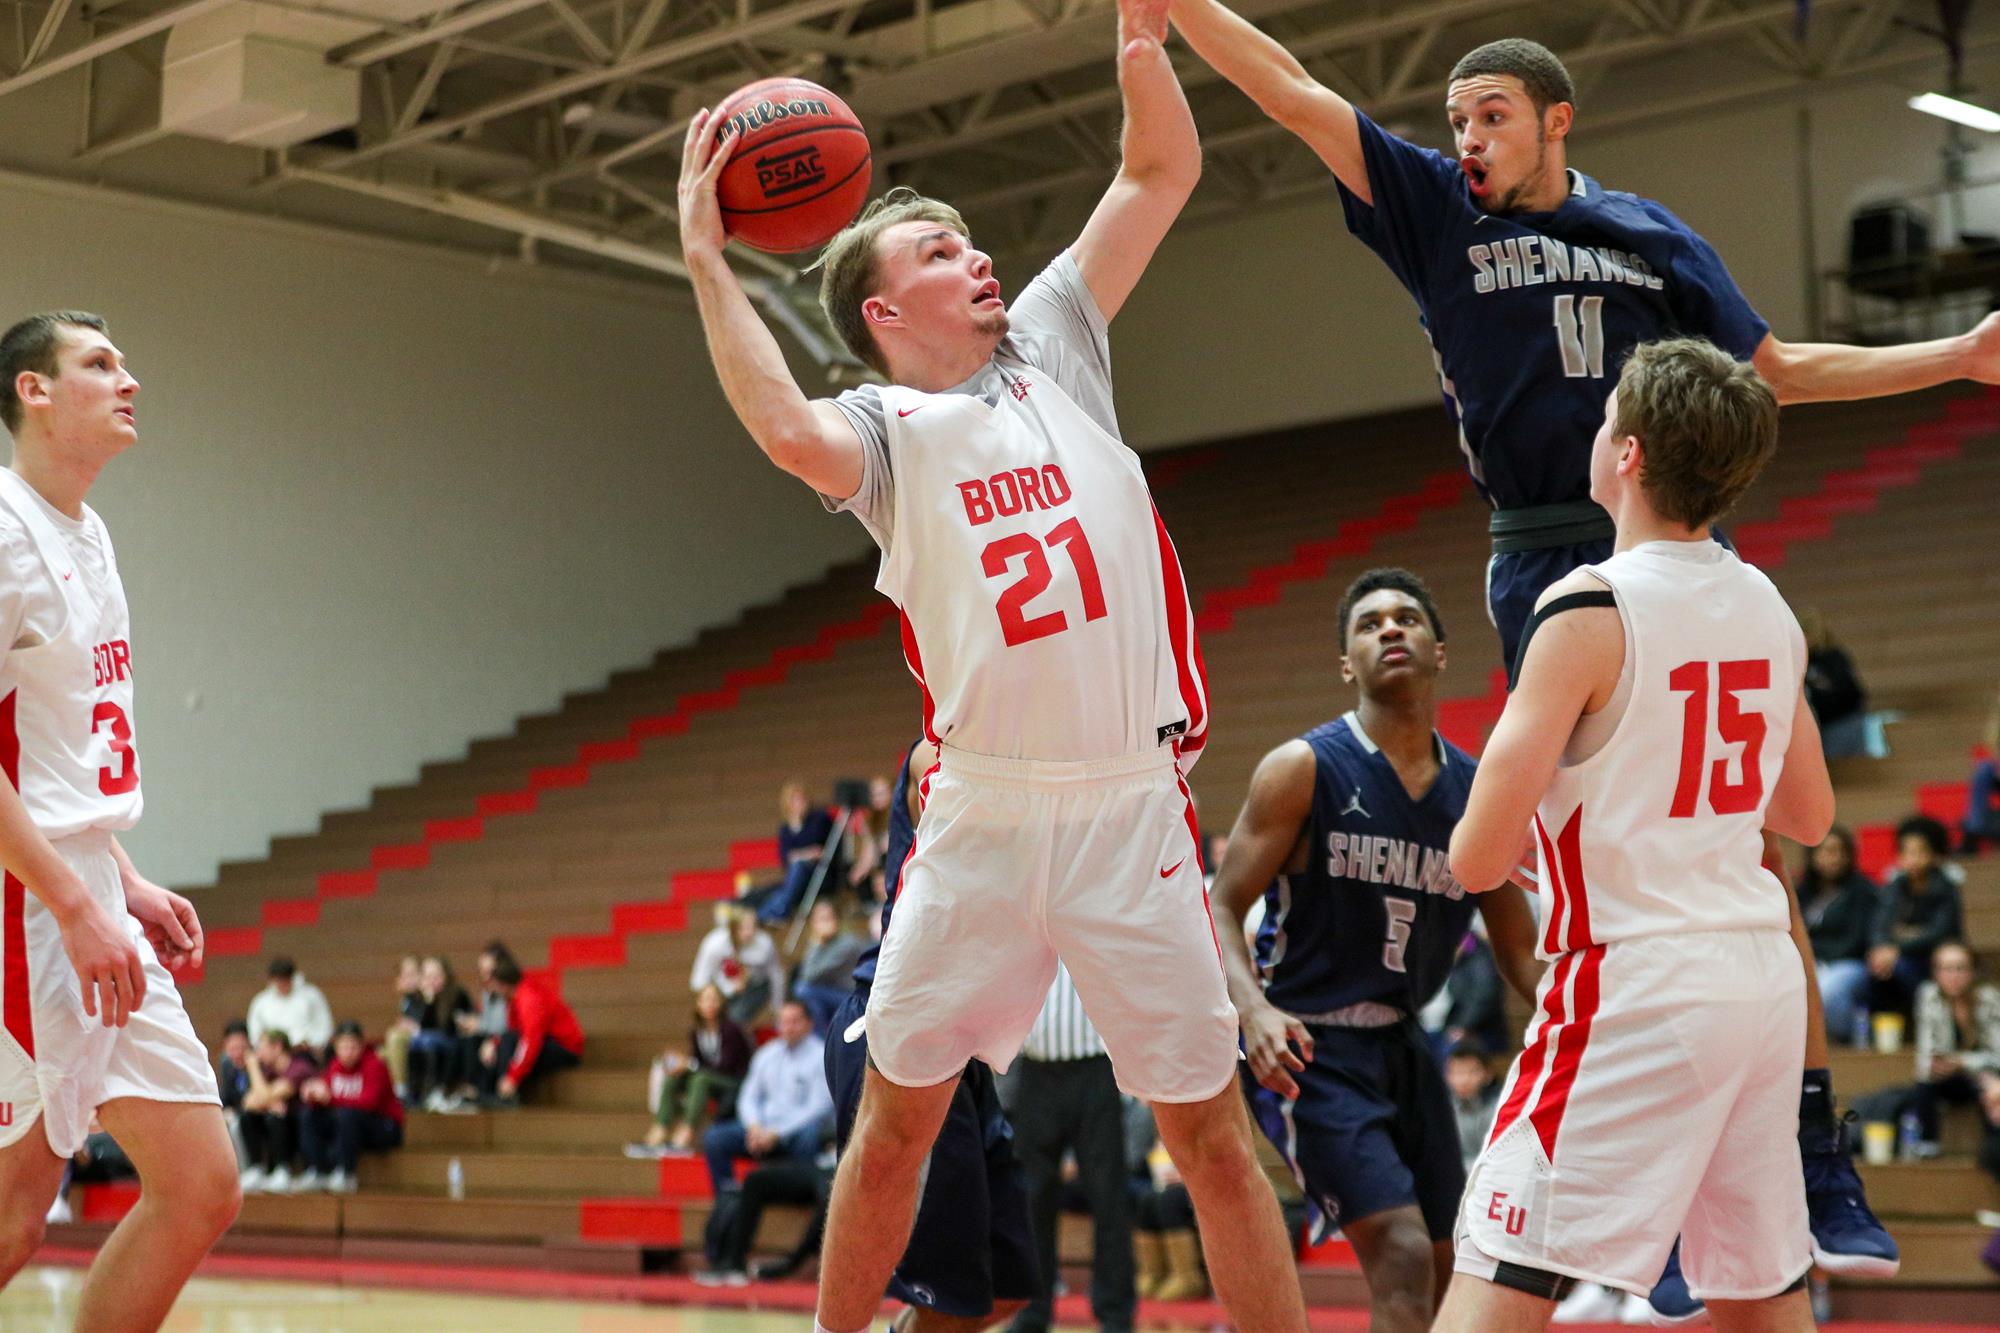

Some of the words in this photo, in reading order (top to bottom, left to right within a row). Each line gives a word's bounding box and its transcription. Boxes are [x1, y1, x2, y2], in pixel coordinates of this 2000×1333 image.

[756, 153, 825, 188] PSAC
[1553, 294, 1605, 378] 11
[955, 463, 1072, 527] BORO
[980, 516, 1108, 647] 21
[92, 701, 139, 796] 3
[1164, 726, 1180, 737] XL
[1669, 659, 1770, 818] 15
[1382, 896, 1417, 973] 5
[1487, 1191, 1527, 1237] EU
